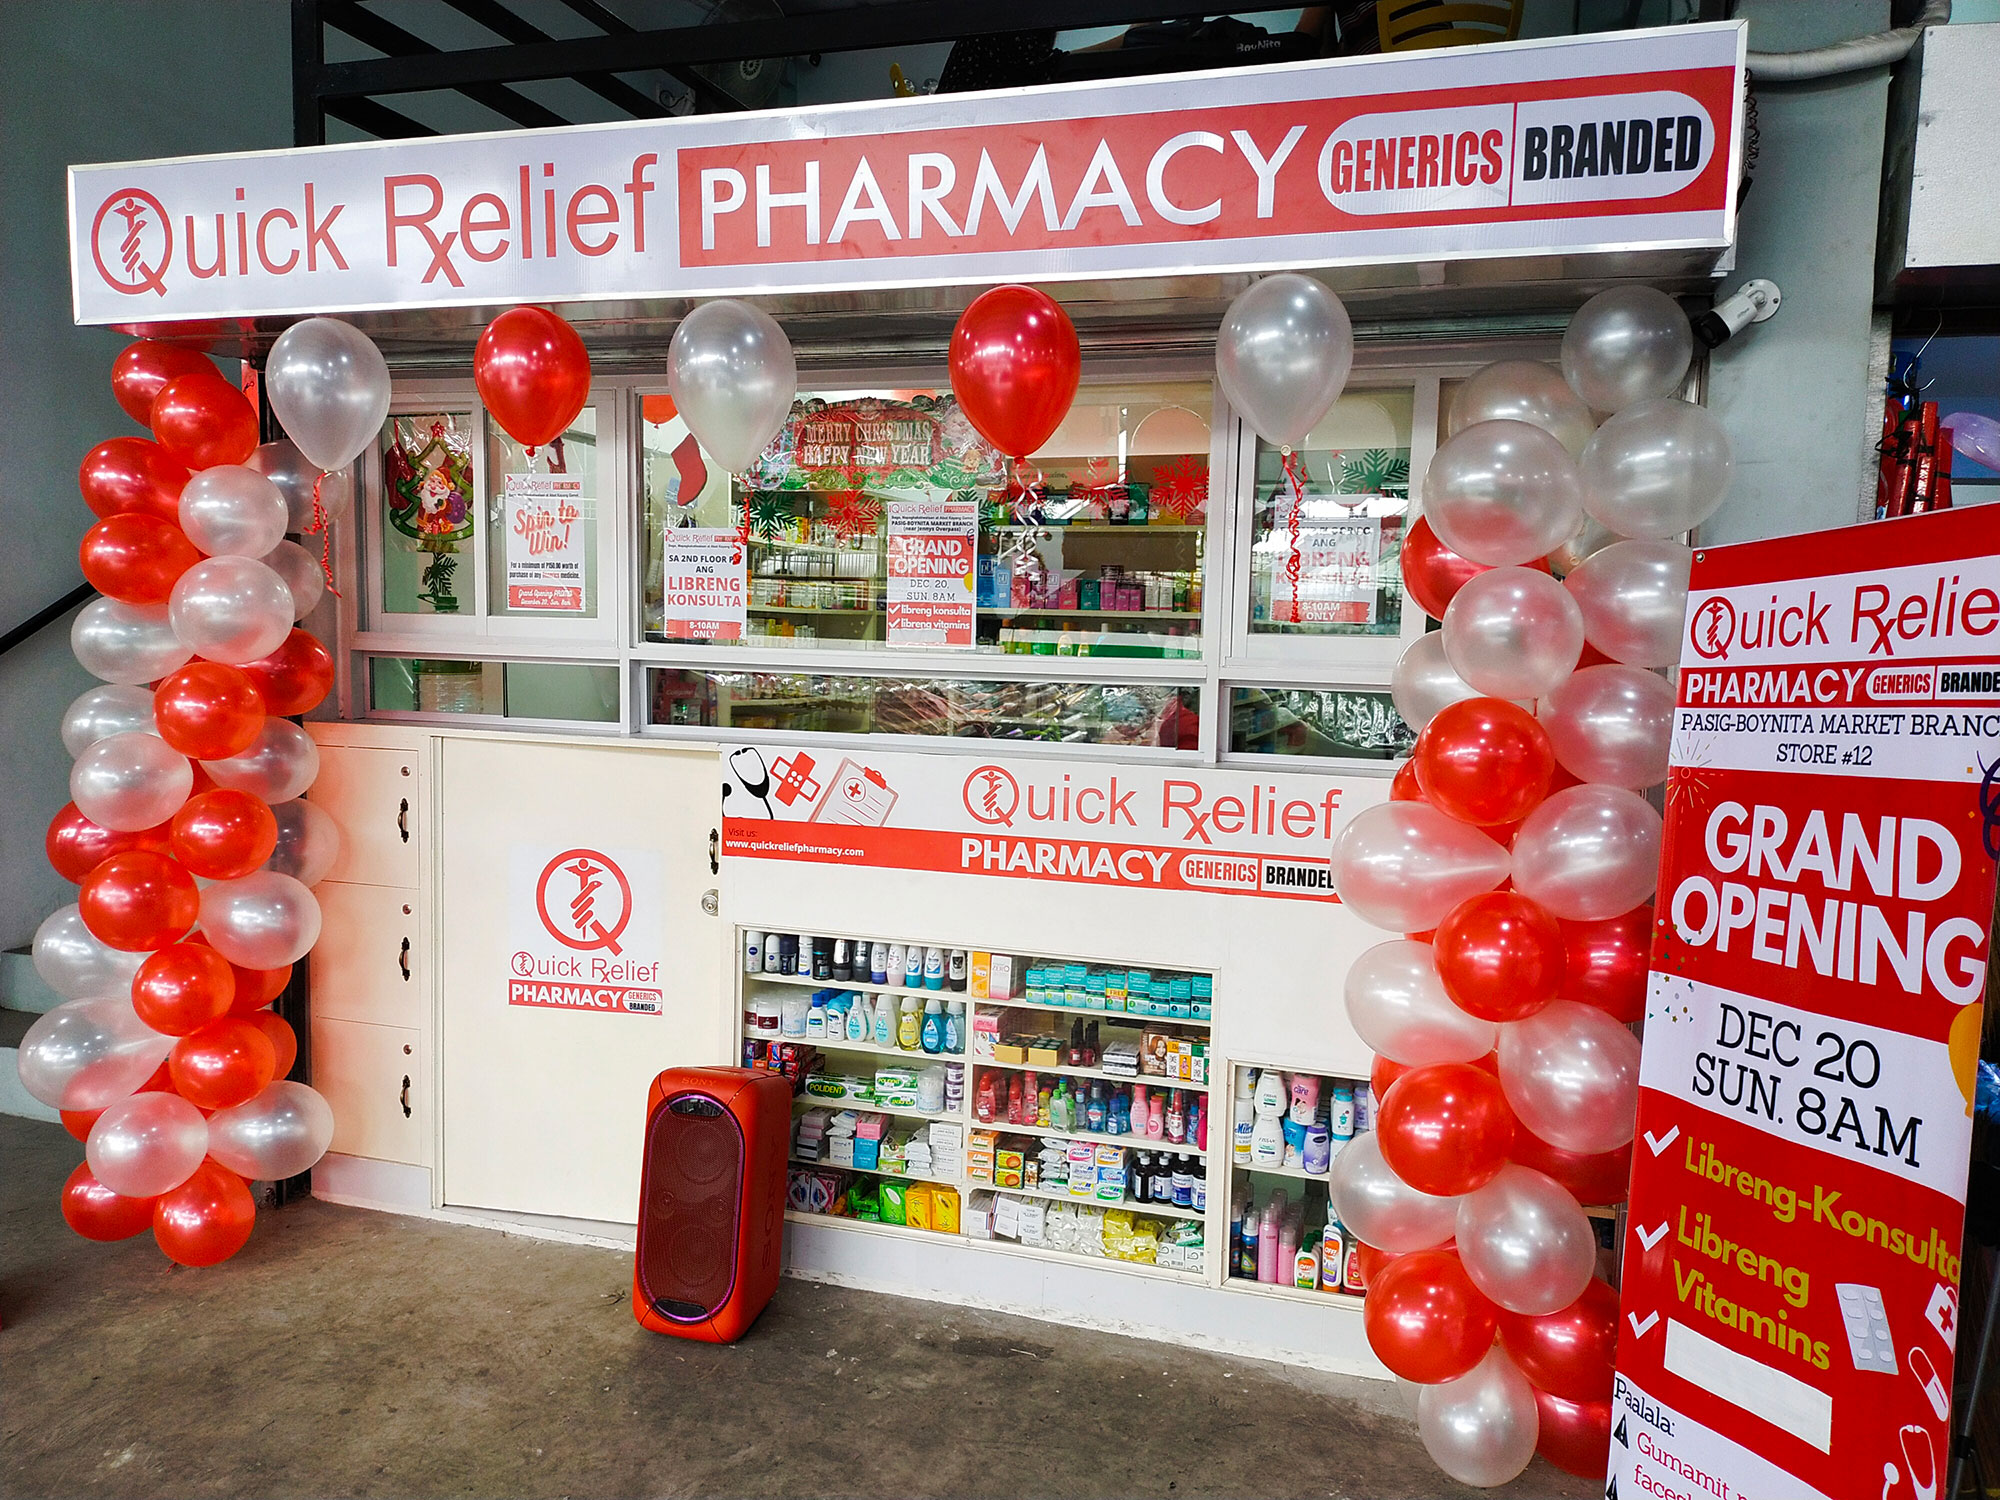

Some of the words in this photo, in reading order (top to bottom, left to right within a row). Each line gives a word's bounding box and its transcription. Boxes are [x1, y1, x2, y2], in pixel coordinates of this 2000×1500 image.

[92, 183, 348, 297] Quick
[700, 126, 1307, 250] PHARMACY
[1330, 129, 1503, 194] GENERICS
[1522, 116, 1701, 182] BRANDED
[805, 422, 851, 444] MERRY
[855, 420, 931, 442] CHRISTMAS
[803, 444, 849, 466] HAPPY
[891, 444, 931, 465] YEAR
[514, 505, 555, 539] Spin
[558, 499, 580, 524] to
[528, 524, 570, 556] Win!
[902, 538, 963, 556] GRAND
[1312, 538, 1337, 548] ANG
[668, 555, 679, 563] SA
[681, 555, 698, 563] 2ND
[700, 555, 727, 564] FLOOR
[695, 566, 714, 574] ANG
[894, 558, 969, 575] OPENING
[668, 576, 741, 592] LIBRENG
[667, 594, 742, 607] KONSULTA
[932, 592, 956, 601] 8AM
[901, 604, 932, 617] libreng
[933, 605, 971, 616] konsulta
[1306, 612, 1336, 620] ONLY
[689, 621, 720, 630] 8-10AM
[693, 630, 717, 638] ONLY
[901, 618, 932, 630] libreng
[933, 619, 970, 630] vitamins
[1690, 590, 1833, 661] Quick
[1685, 668, 1865, 704] PHARMACY
[1872, 673, 1932, 695] GENERICS
[1680, 712, 1815, 734] PASIG-BOYNITA
[1819, 713, 1906, 735] MARKET
[1776, 743, 1838, 765] STORE
[1841, 745, 1874, 767] #12
[963, 765, 1138, 828] Quick
[728, 827, 745, 837] Visit
[746, 829, 758, 838] us:
[725, 840, 865, 857] www.quickreliefpharmacy.com
[1704, 801, 1962, 902] GRAND
[960, 838, 1172, 884] PHARMACY
[1185, 859, 1257, 883] GENERICS
[1265, 865, 1334, 890] BRANDE
[1671, 875, 1987, 1006] OPENING
[511, 951, 583, 978] Quick
[511, 983, 622, 1009] PHARMACY
[628, 991, 657, 1001] GENERICS
[629, 1002, 656, 1012] BRANDED
[1716, 1002, 1802, 1068] DEC
[1813, 1031, 1882, 1090] 20
[681, 1076, 717, 1086] SONY
[809, 1083, 844, 1095] POLIDENT
[1691, 1052, 1785, 1126] SUN.
[1795, 1086, 1924, 1169] 8AM
[1684, 1135, 1962, 1286] Libreng-Konsulta
[1677, 1203, 1811, 1309] Libreng
[1672, 1258, 1832, 1371] Vitamins
[1613, 1376, 1677, 1438] Paalala:
[1636, 1431, 1731, 1500] Gumamit
